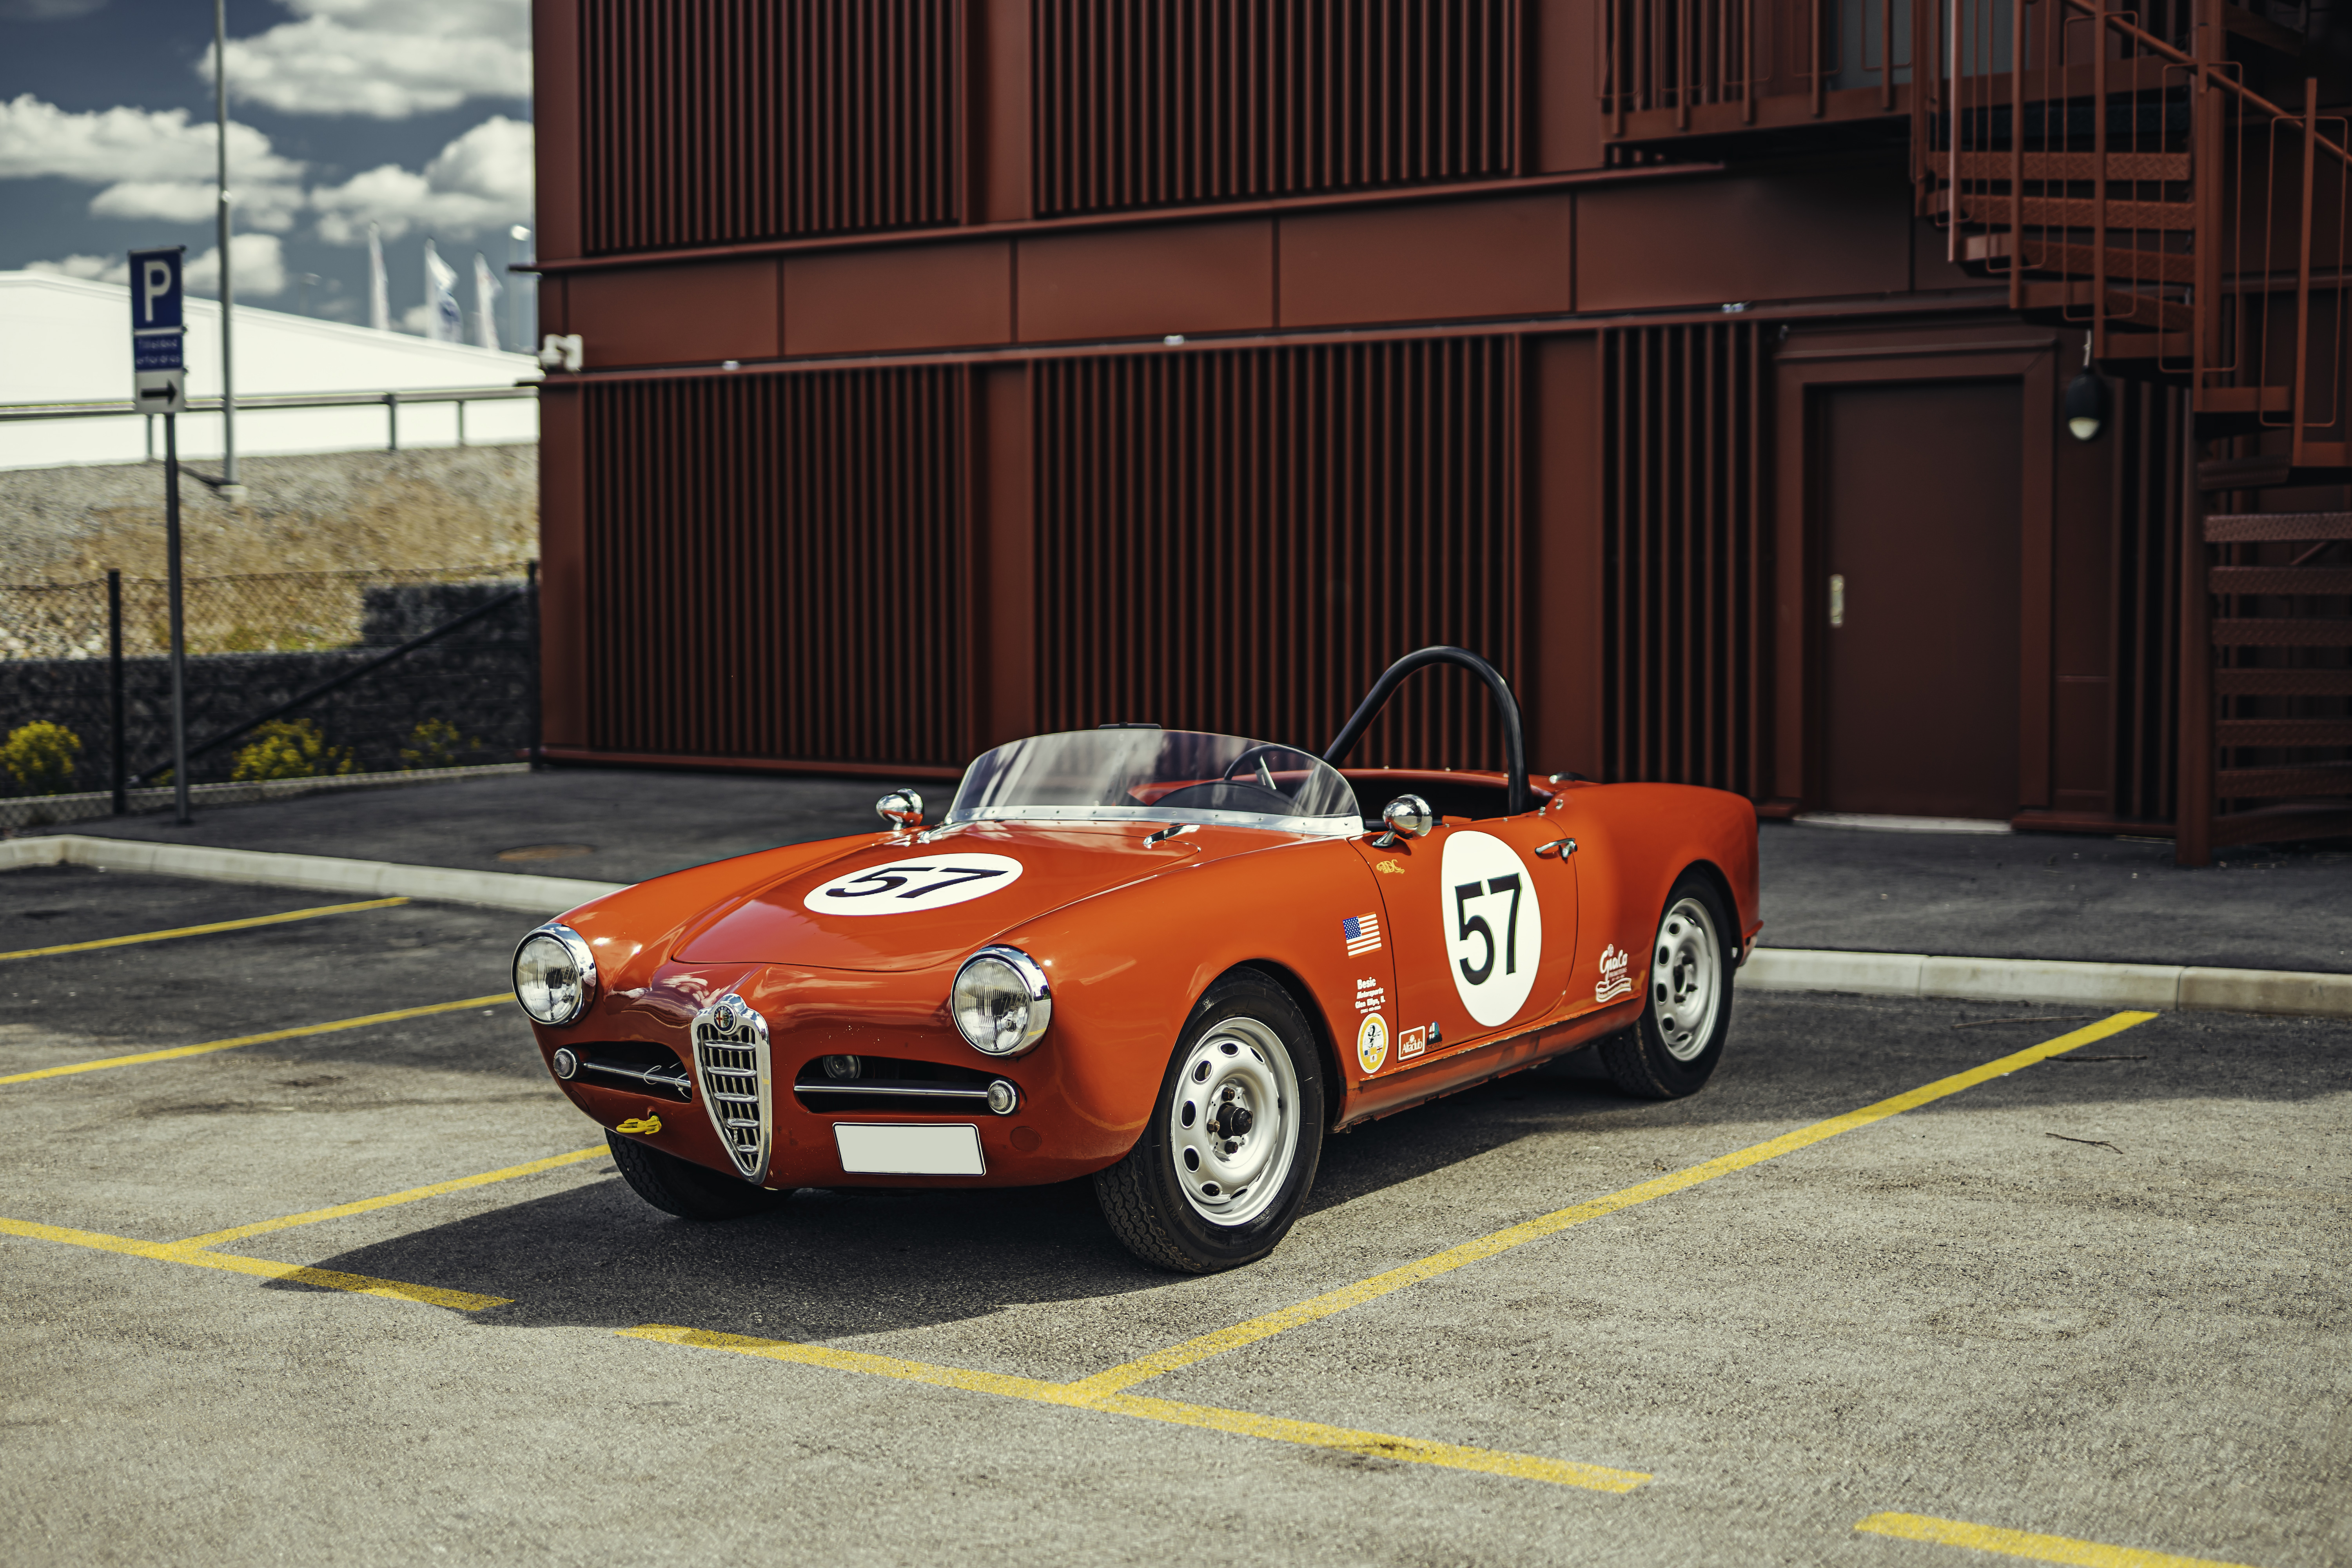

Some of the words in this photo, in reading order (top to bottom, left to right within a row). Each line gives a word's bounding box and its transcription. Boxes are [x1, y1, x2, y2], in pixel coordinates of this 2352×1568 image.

[143, 260, 172, 322] P
[825, 867, 1009, 898] 57
[1454, 873, 1523, 985] 57
[1356, 987, 1384, 999] Motorsports
[1154, 1163, 1180, 1225] VREDESTEIN
